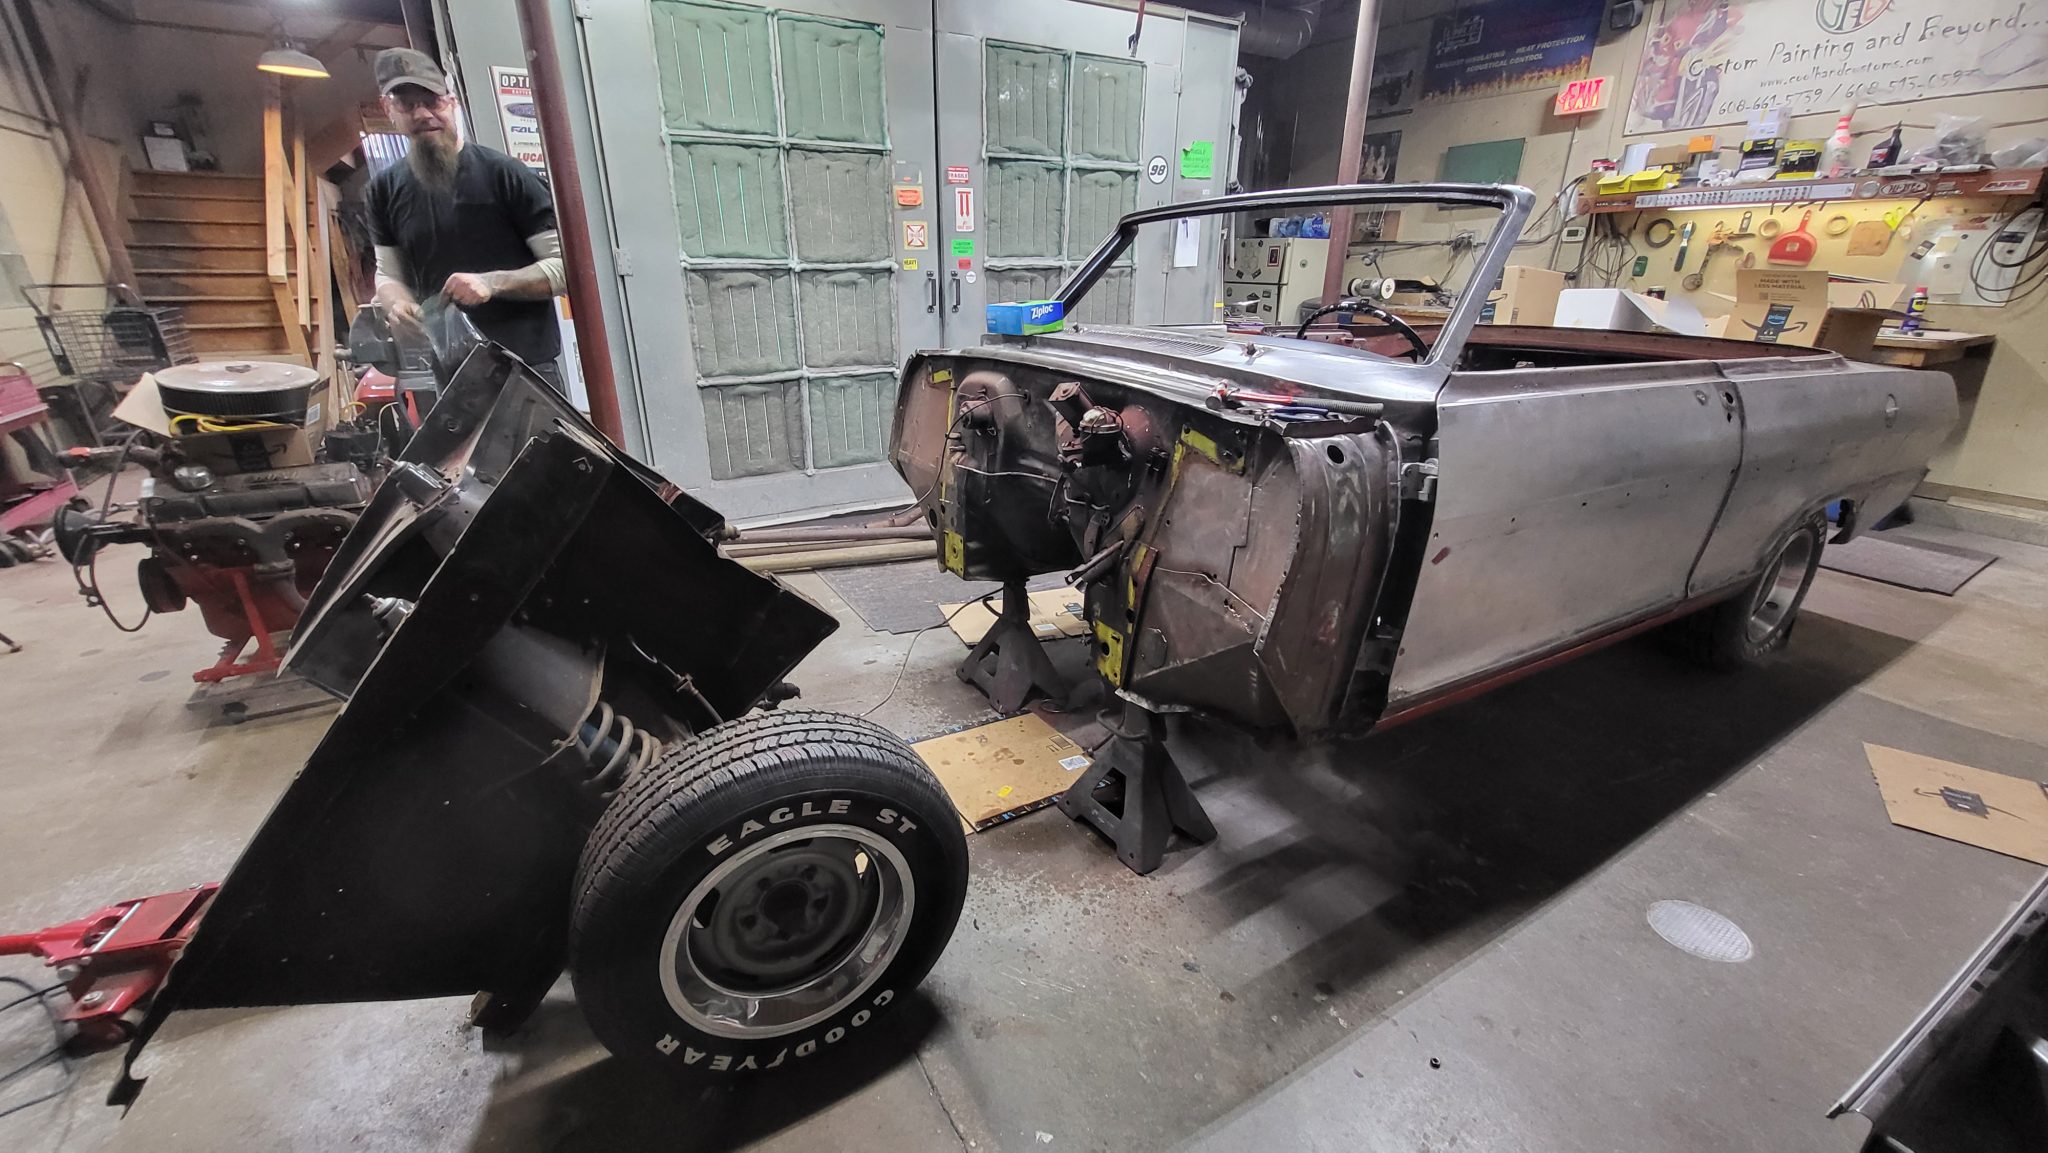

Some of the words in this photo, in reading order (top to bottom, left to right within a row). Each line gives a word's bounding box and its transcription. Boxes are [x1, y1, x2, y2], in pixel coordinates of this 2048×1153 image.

[1515, 44, 1537, 54] HEAT
[1536, 34, 1586, 50] PROTECTION
[1689, 58, 1758, 77] Cstom
[1768, 39, 1855, 66] Painting
[1866, 22, 1912, 51] and
[1509, 53, 1544, 65] CONTROL
[501, 75, 530, 88] OPTI
[1564, 78, 1605, 111] EXIT
[517, 152, 544, 163] LUCA
[1030, 304, 1054, 320] Ziploc
[706, 800, 852, 857] EAGLE
[875, 808, 918, 834] ST
[655, 988, 895, 1072] GOODYEAR
